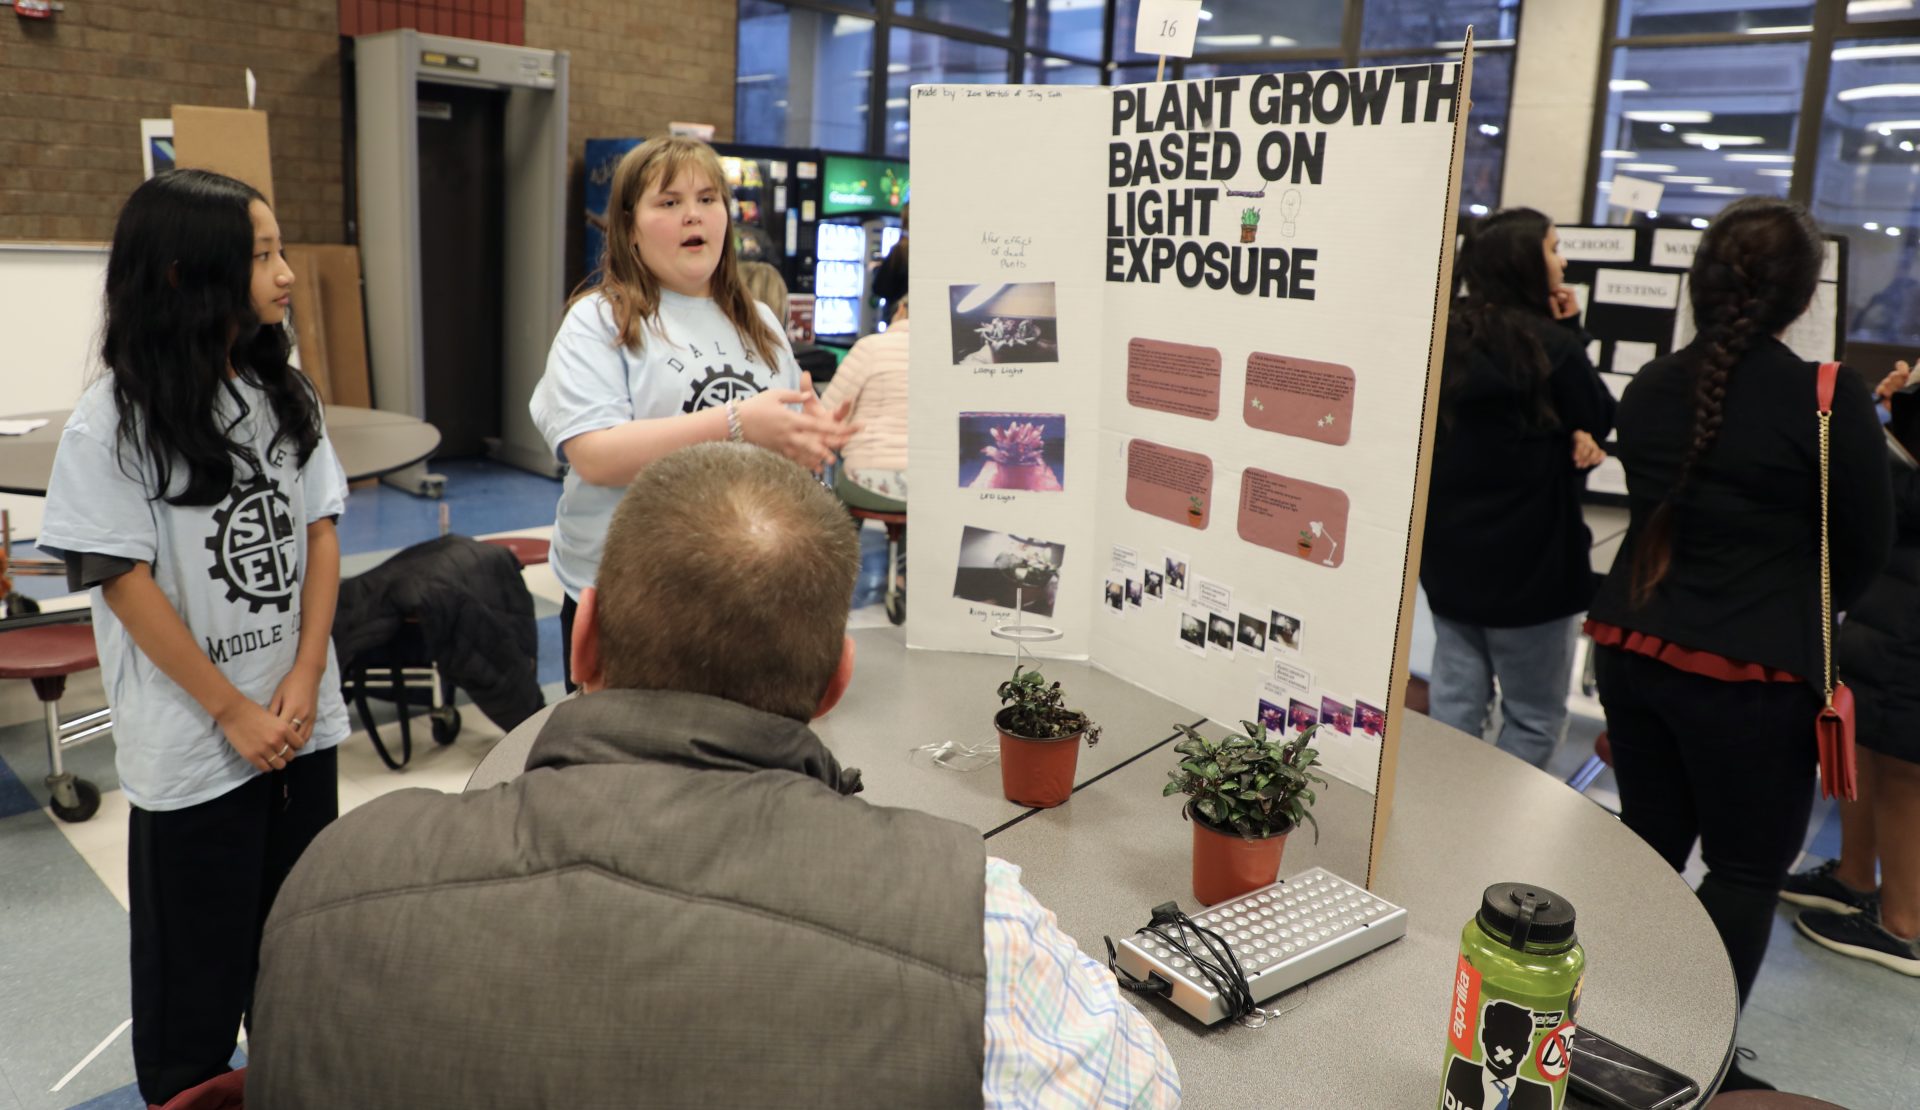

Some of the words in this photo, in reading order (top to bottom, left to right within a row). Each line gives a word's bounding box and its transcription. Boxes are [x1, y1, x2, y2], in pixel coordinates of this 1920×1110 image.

[1160, 20, 1178, 37] 16
[1112, 78, 1240, 135] PLANT
[1249, 64, 1462, 125] GROWTH
[1109, 131, 1241, 187] BASED
[1257, 130, 1326, 185] ON
[1107, 187, 1219, 237] LIGHT
[1106, 238, 1318, 300] EXPOSURE
[1564, 239, 1623, 250] SCHOOL
[1607, 283, 1668, 297] TESTING
[1454, 971, 1470, 1039] aprilia
